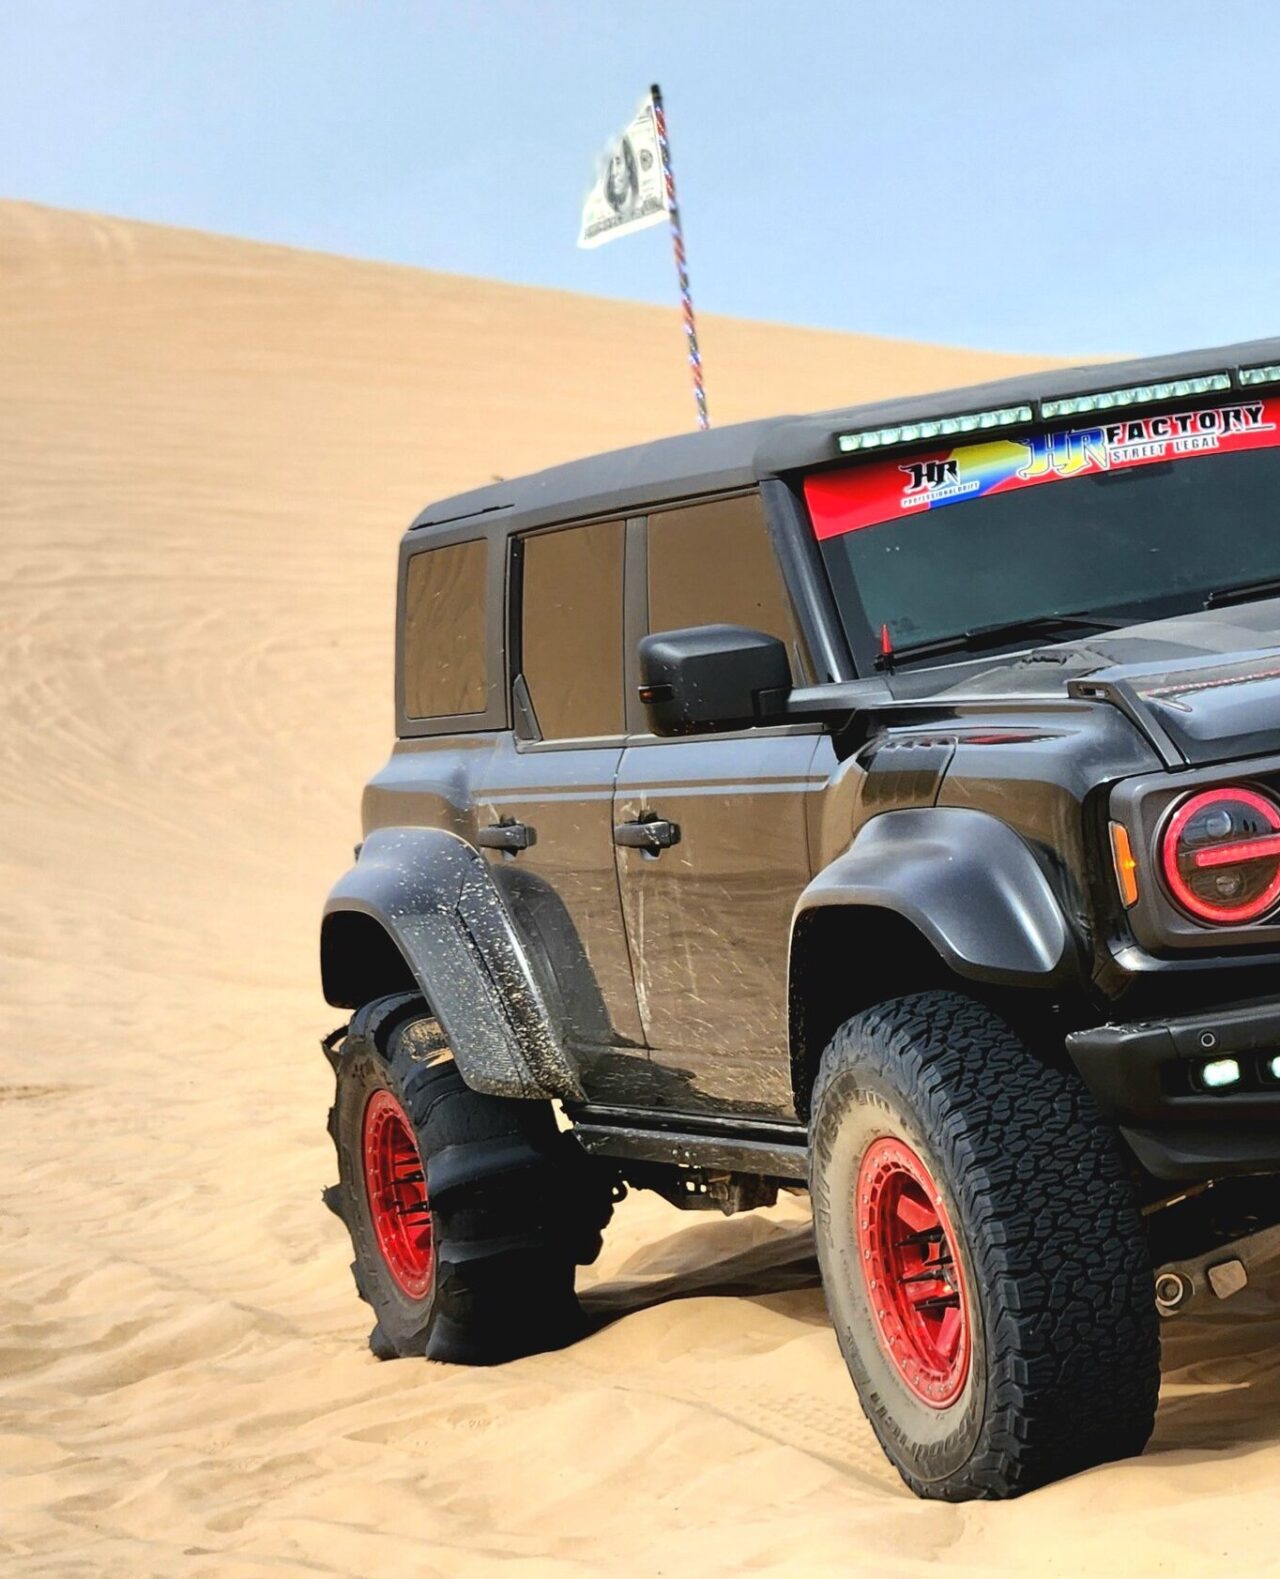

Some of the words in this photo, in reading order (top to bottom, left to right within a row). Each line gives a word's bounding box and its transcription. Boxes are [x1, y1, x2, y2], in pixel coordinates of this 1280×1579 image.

[1106, 405, 1264, 444] FACTORY
[1112, 444, 1165, 462] STREET
[1175, 436, 1218, 452] LEGAL
